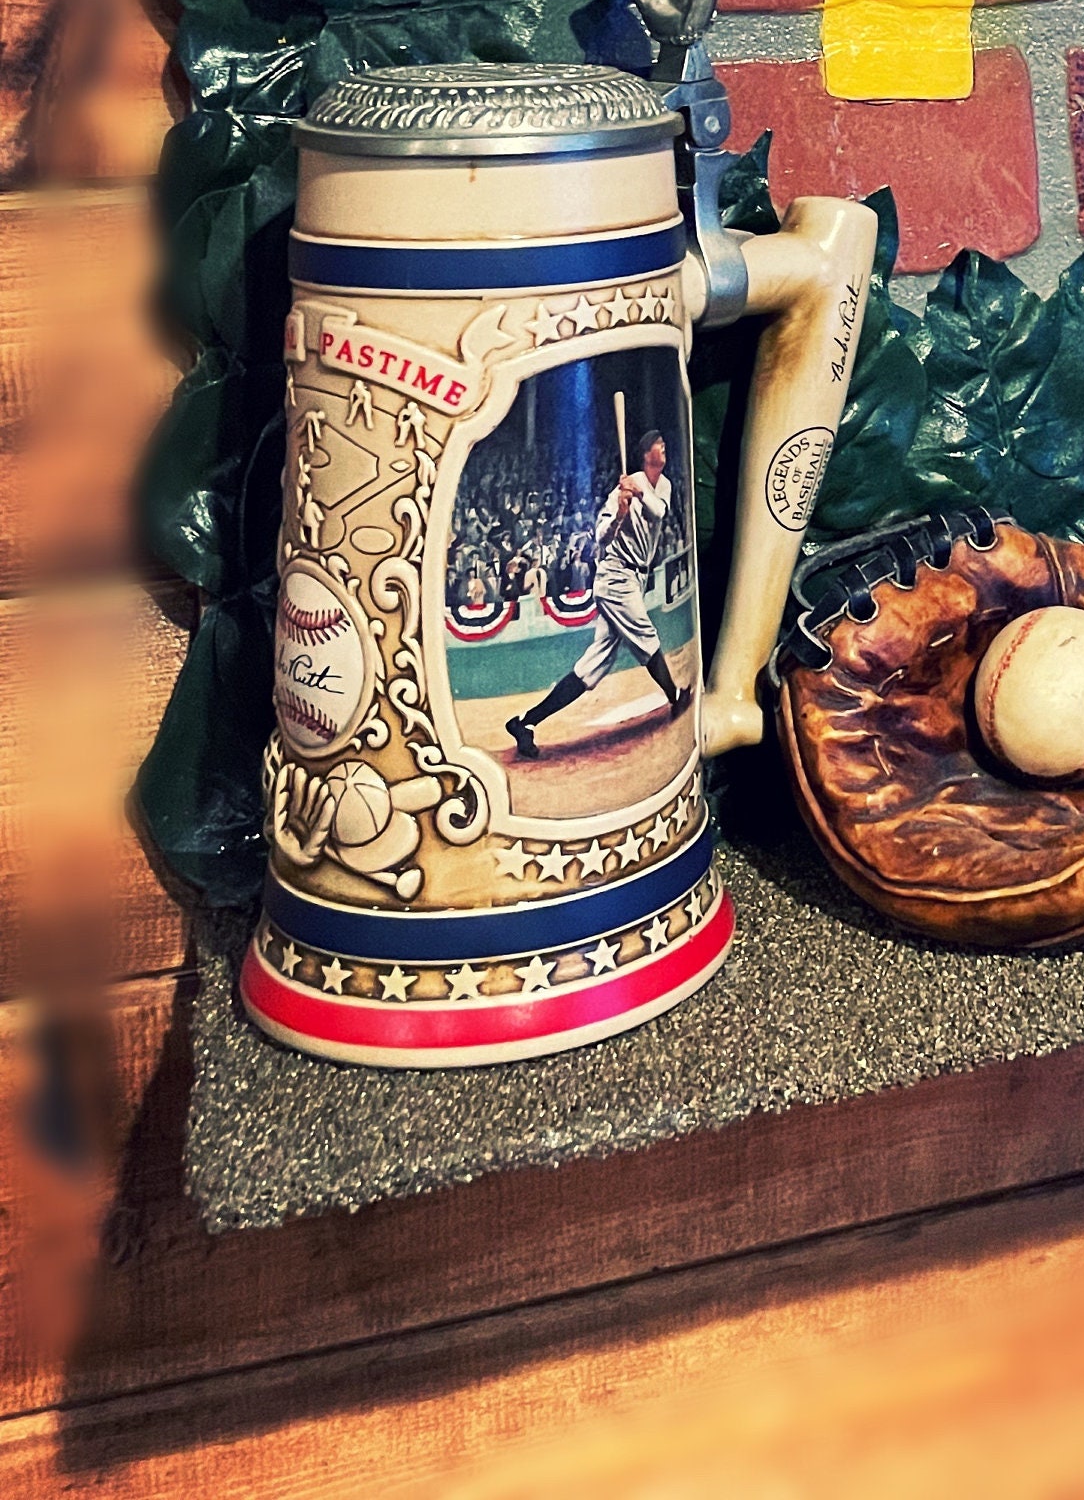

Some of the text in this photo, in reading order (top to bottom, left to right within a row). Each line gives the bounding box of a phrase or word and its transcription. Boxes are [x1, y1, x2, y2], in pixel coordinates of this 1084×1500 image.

[320, 331, 469, 407] PASTIME
[772, 437, 811, 514] LEGENDS
[791, 466, 803, 484] OF
[791, 440, 825, 521] BASEBALL
